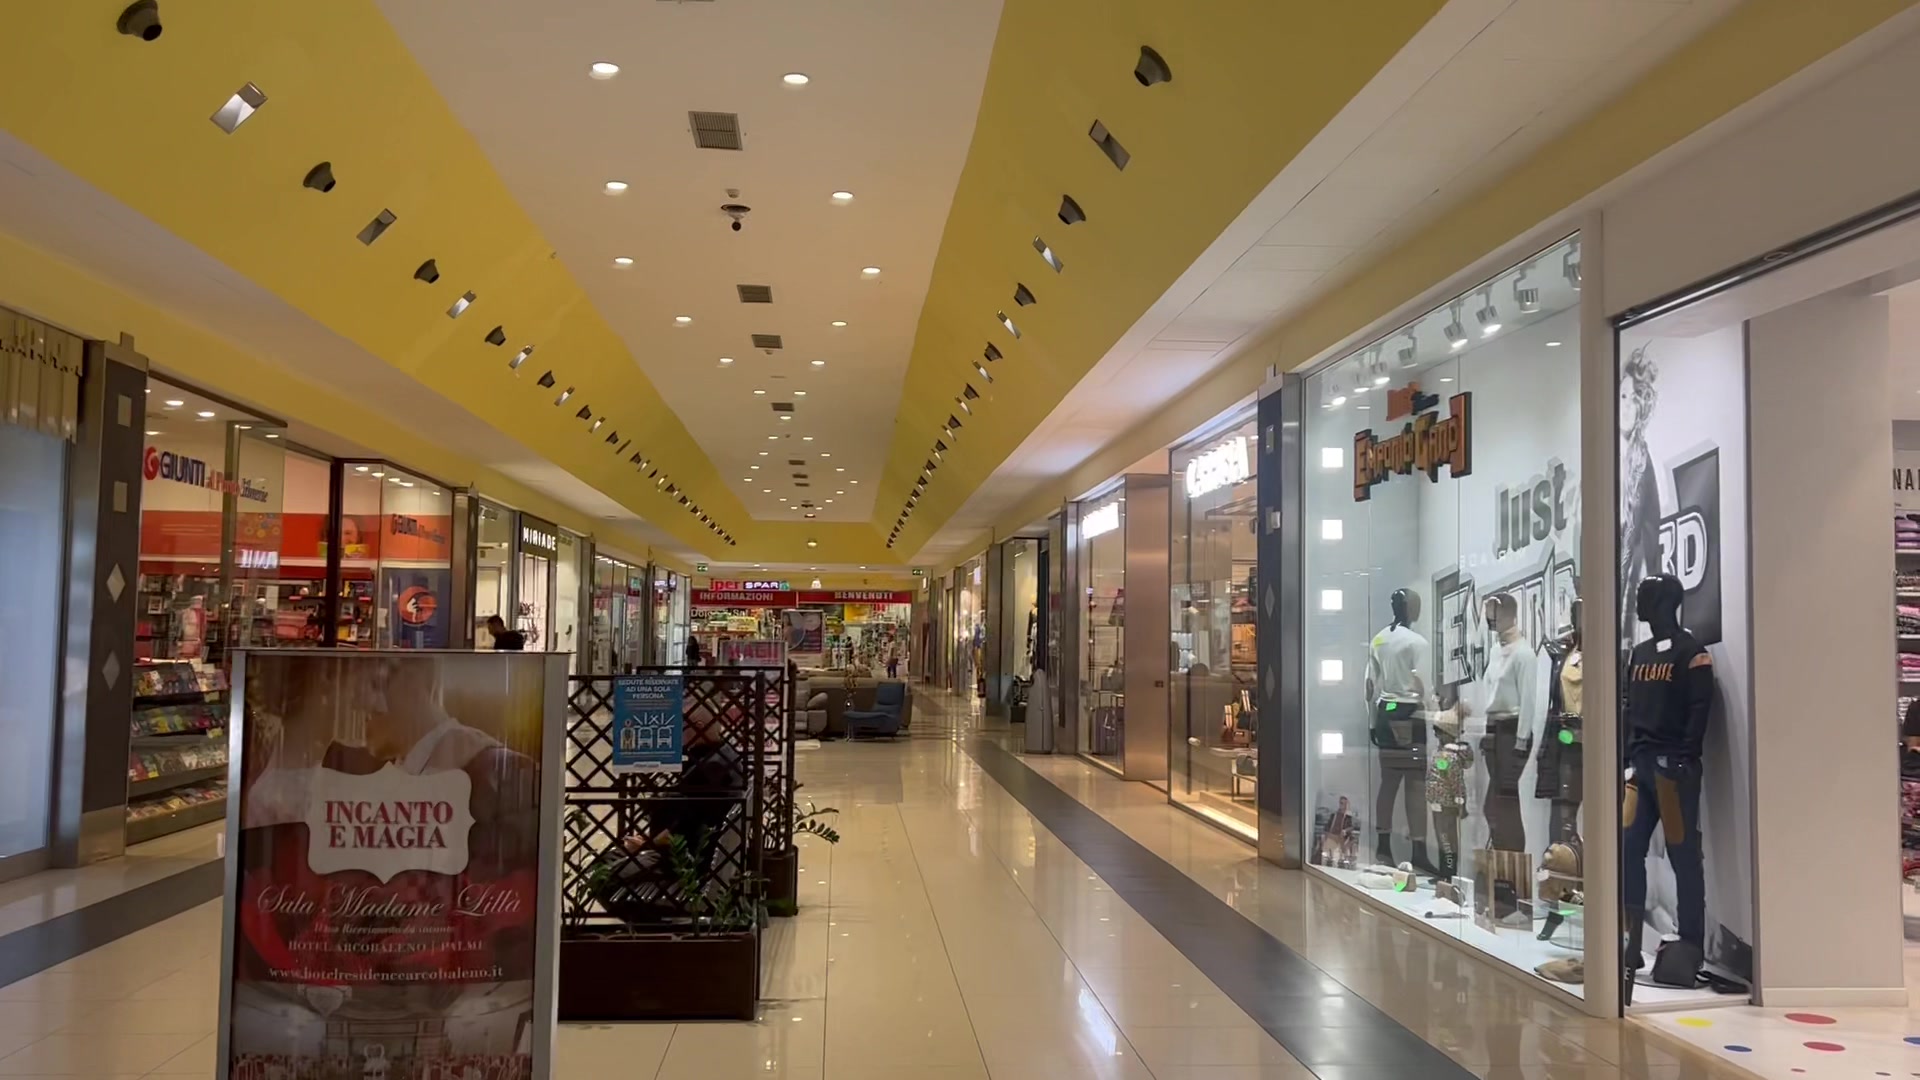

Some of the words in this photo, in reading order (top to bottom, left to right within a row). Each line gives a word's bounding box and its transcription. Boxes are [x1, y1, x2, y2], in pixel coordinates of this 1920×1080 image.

[160, 451, 205, 487] GIUNTI
[1893, 468, 1920, 490] NA
[745, 581, 779, 589] SPAR
[700, 592, 774, 600] INFORMAZIONI
[834, 592, 893, 600] BENVENUTI
[325, 800, 454, 824] INCANTO
[328, 826, 346, 848] E
[353, 826, 448, 848] MAGIA
[257, 883, 315, 915] Sala
[321, 883, 446, 918] Madame
[288, 940, 328, 951] HOTEL
[336, 942, 427, 953] ARCOBALENO
[441, 940, 483, 951] PALMI
[269, 965, 504, 981] www.hotelresidencearcobaleno.it
